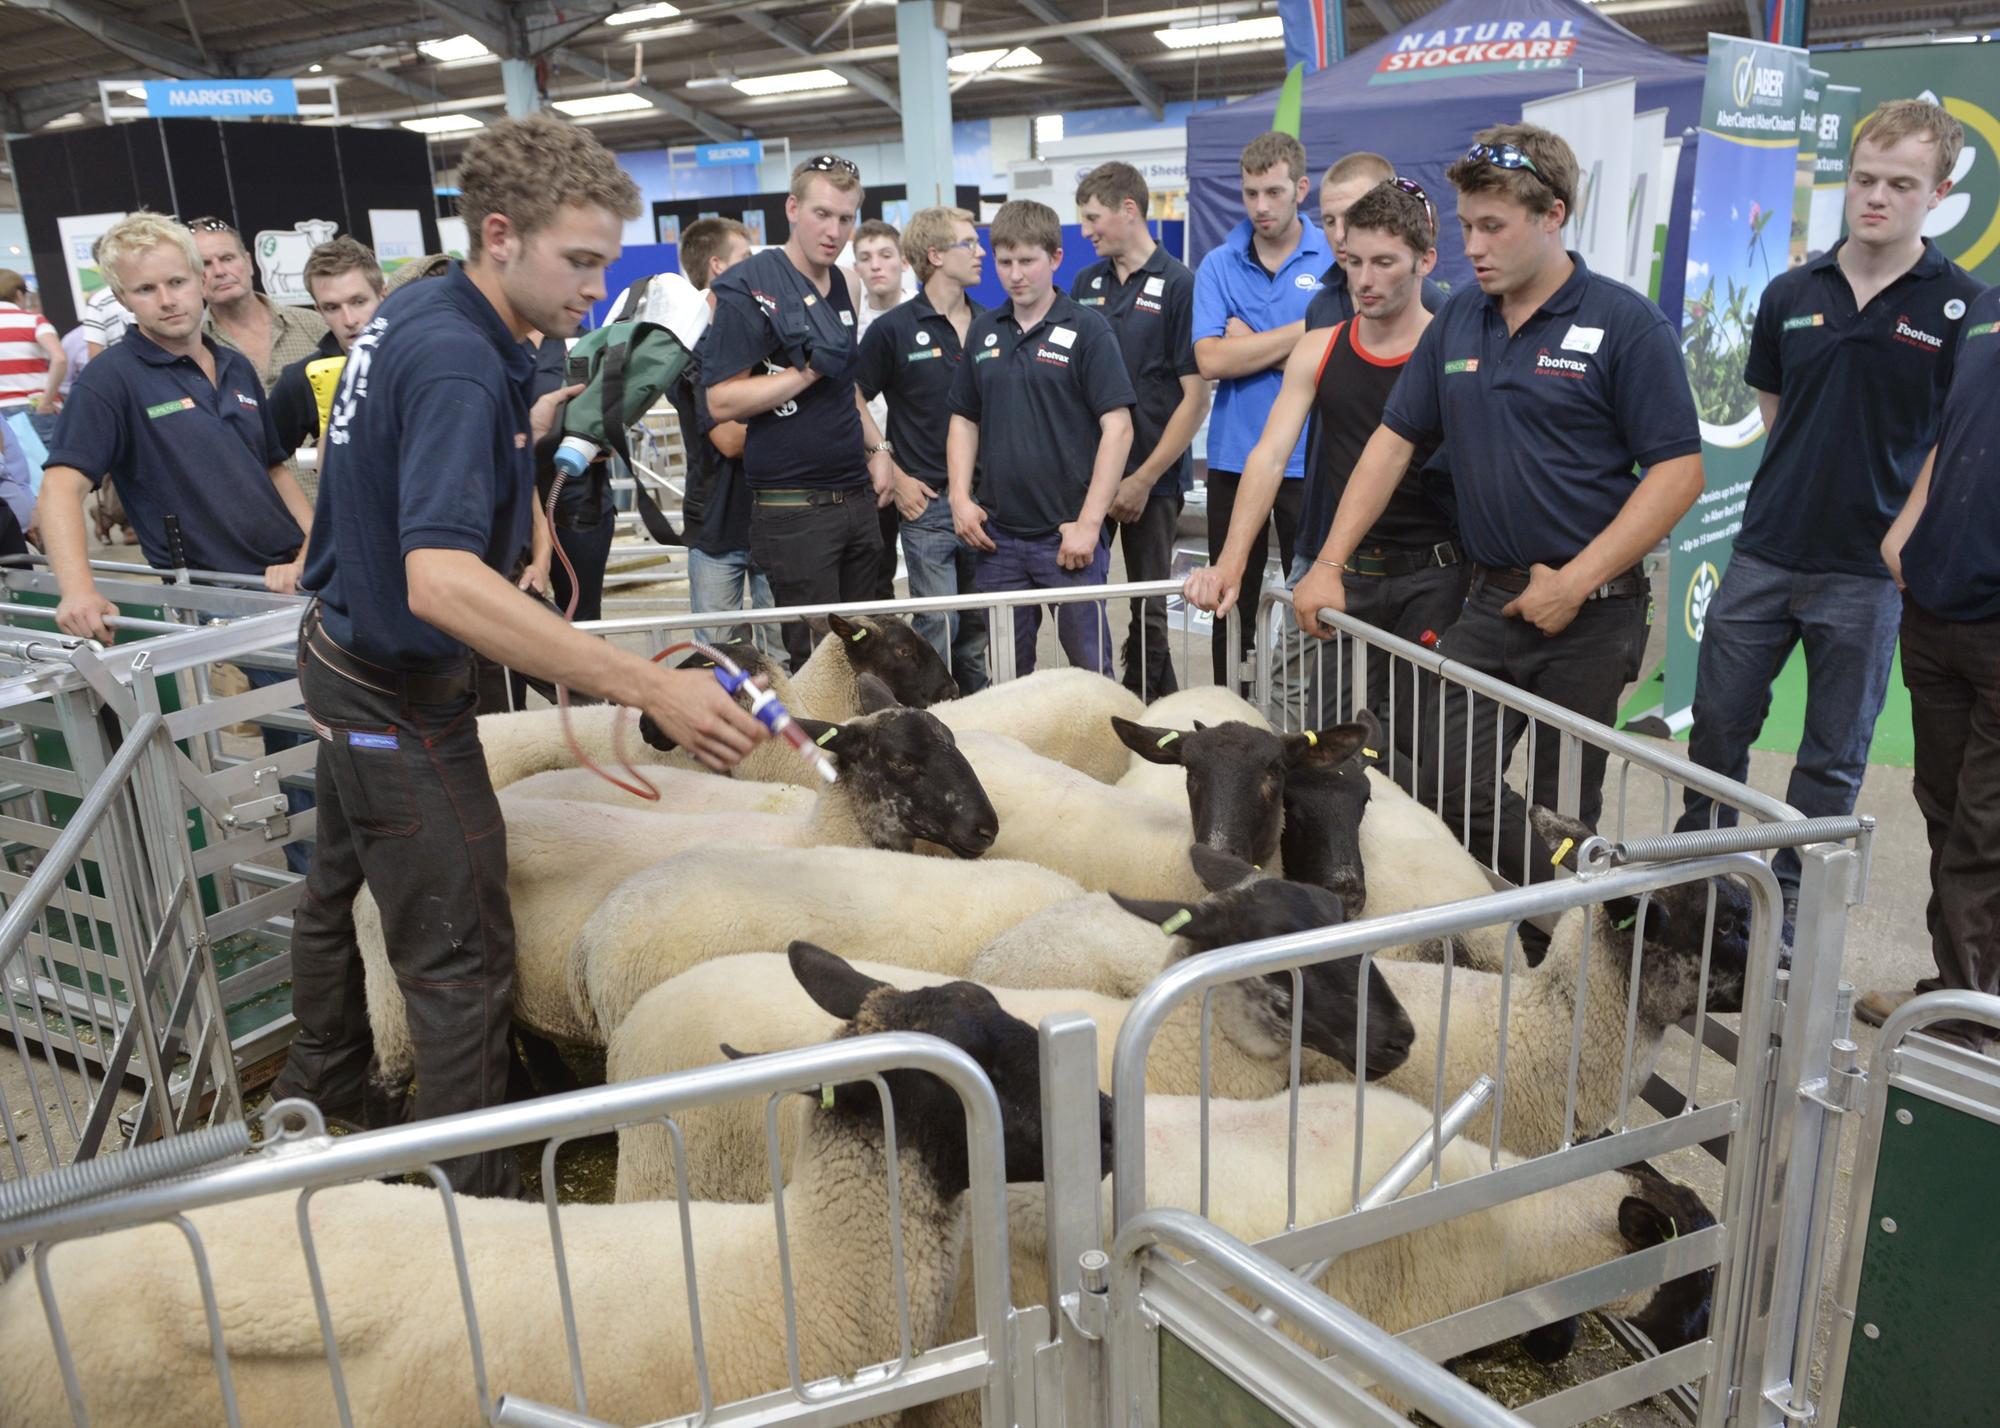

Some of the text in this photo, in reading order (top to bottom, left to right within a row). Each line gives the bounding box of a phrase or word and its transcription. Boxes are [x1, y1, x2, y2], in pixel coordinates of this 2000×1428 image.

[1397, 20, 1575, 51] NATURAL
[1387, 40, 1572, 71] STOCKCARE
[1516, 57, 1562, 71] LTD
[1752, 66, 1784, 98] ABER
[168, 88, 274, 107] MARKETING
[707, 147, 750, 161] SELECTION
[1896, 321, 1943, 348] Footvax
[1037, 348, 1070, 363] Footvax
[1537, 354, 1588, 373] Footvax
[1683, 538, 1692, 553] Up
